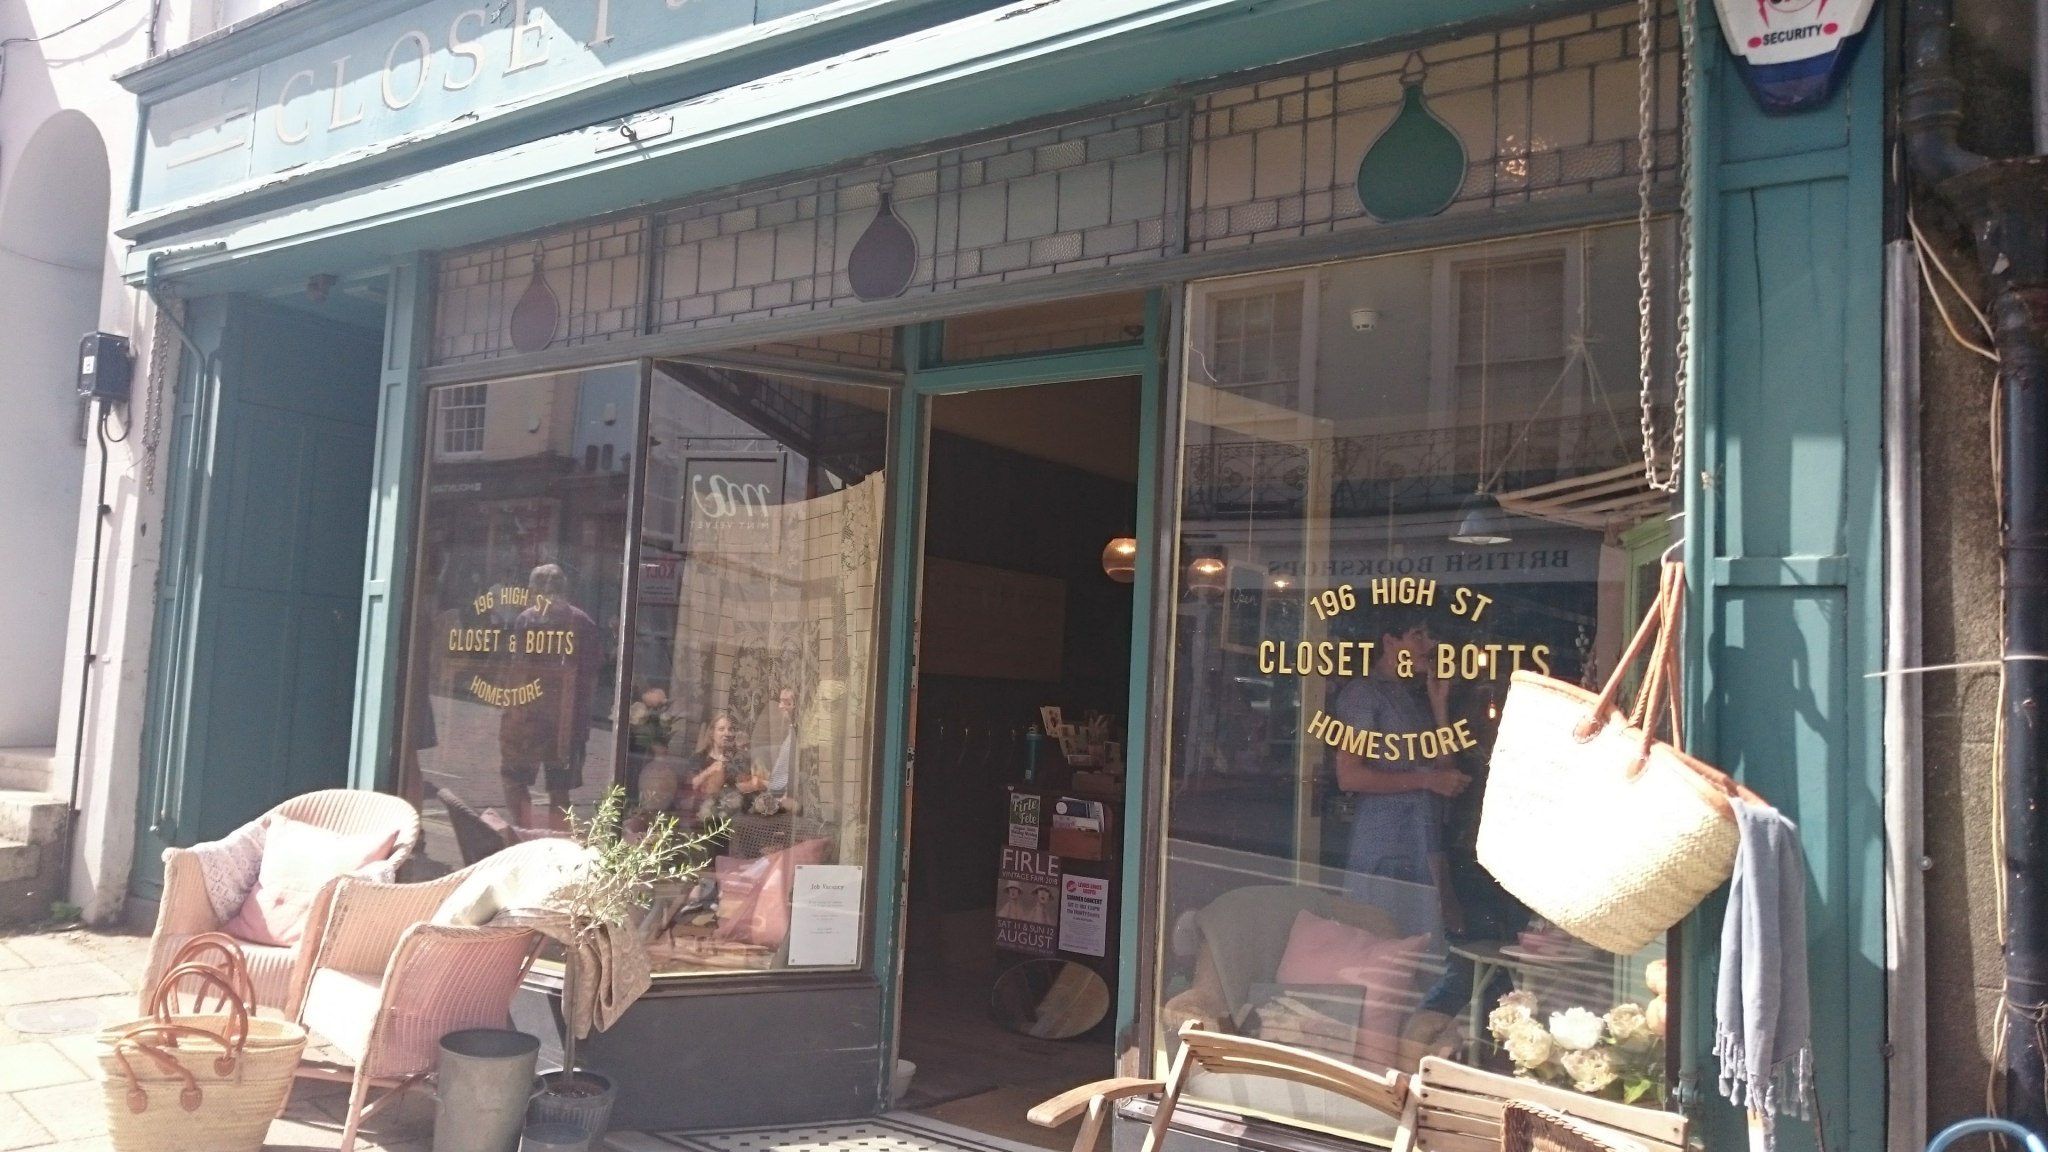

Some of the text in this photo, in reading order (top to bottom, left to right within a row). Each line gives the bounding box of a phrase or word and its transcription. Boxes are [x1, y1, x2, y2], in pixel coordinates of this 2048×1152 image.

[1763, 24, 1822, 46] SECURITY
[473, 587, 552, 616] 196 HIGH ST
[1310, 577, 1493, 623] 196 HIGH ST
[449, 628, 574, 655] CLOSET & BOTTS
[1258, 640, 1550, 681] CLOSET & BOTTS
[470, 675, 543, 707] HOMESTORE
[1307, 710, 1477, 761] HOMESTORE
[1013, 799, 1037, 812] Firle
[1002, 848, 1060, 877] FIRLE
[810, 883, 820, 891] Job
[1002, 871, 1030, 881] VINTAGE
[1030, 874, 1044, 884] FAIR
[997, 919, 1011, 929] SAT
[1030, 925, 1045, 934] SUN
[1047, 928, 1054, 936] 12
[997, 928, 1053, 949] AUGUST
